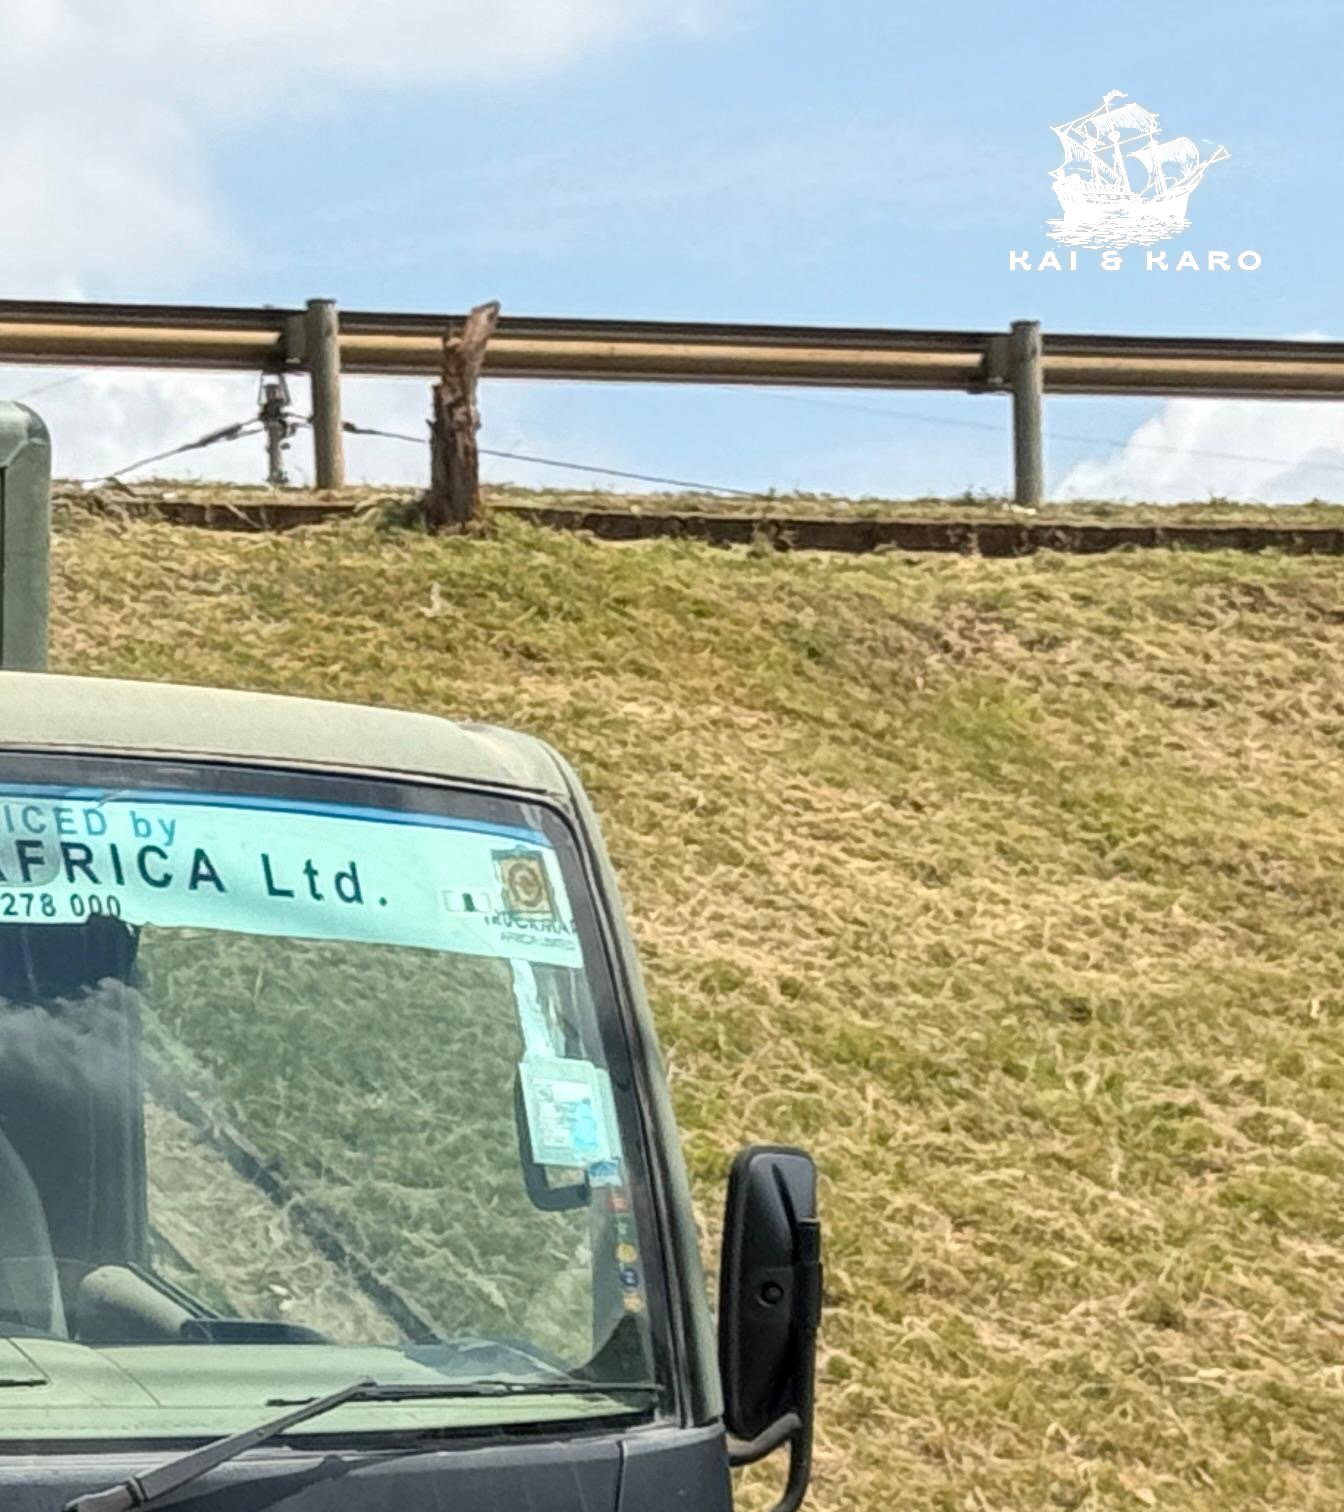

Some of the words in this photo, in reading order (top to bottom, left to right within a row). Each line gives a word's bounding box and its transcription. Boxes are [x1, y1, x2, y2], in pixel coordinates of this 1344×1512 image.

[130, 810, 177, 847] by
[260, 852, 388, 906] Ltd.
[2, 894, 57, 917] 278
[70, 893, 121, 918] 000
